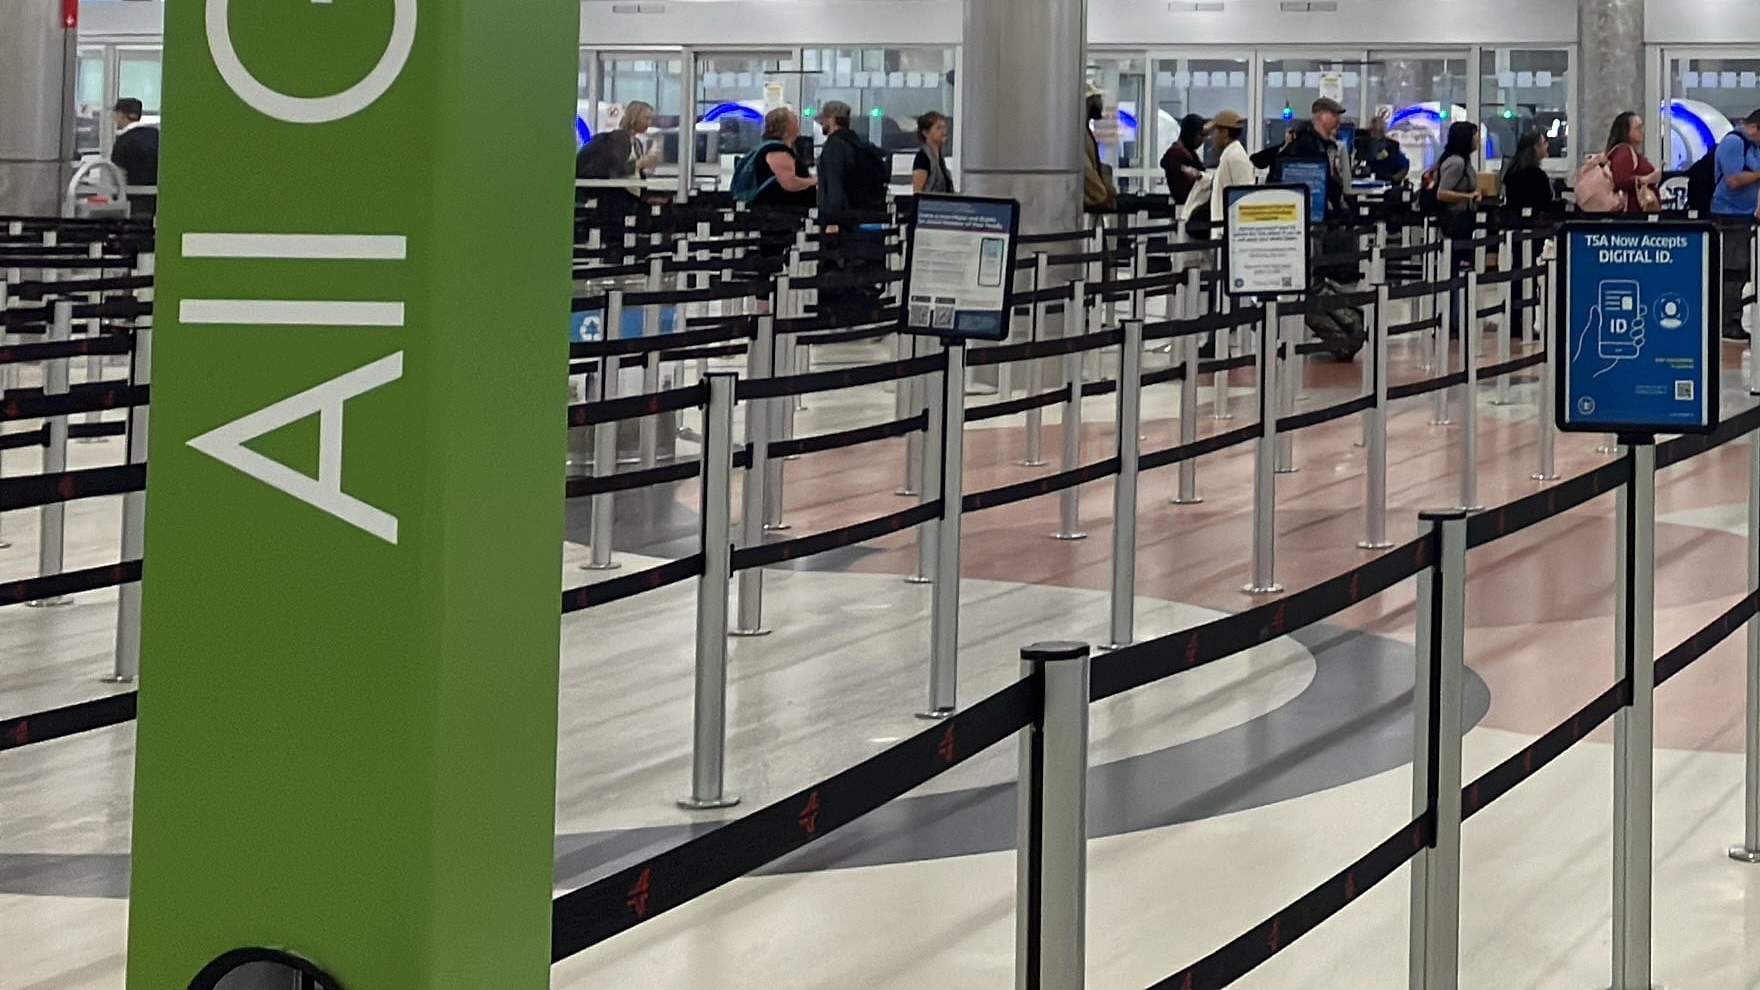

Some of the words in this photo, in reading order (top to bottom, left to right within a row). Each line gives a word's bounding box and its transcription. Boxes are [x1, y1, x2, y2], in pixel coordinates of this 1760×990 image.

[1584, 234, 1609, 247] TSA
[1610, 234, 1639, 248] Now
[1640, 234, 1688, 250] Accepts
[1598, 249, 1653, 264] DIGITAL
[1655, 249, 1674, 264] ID.
[1610, 318, 1628, 334] ID
[179, 232, 407, 545] All
